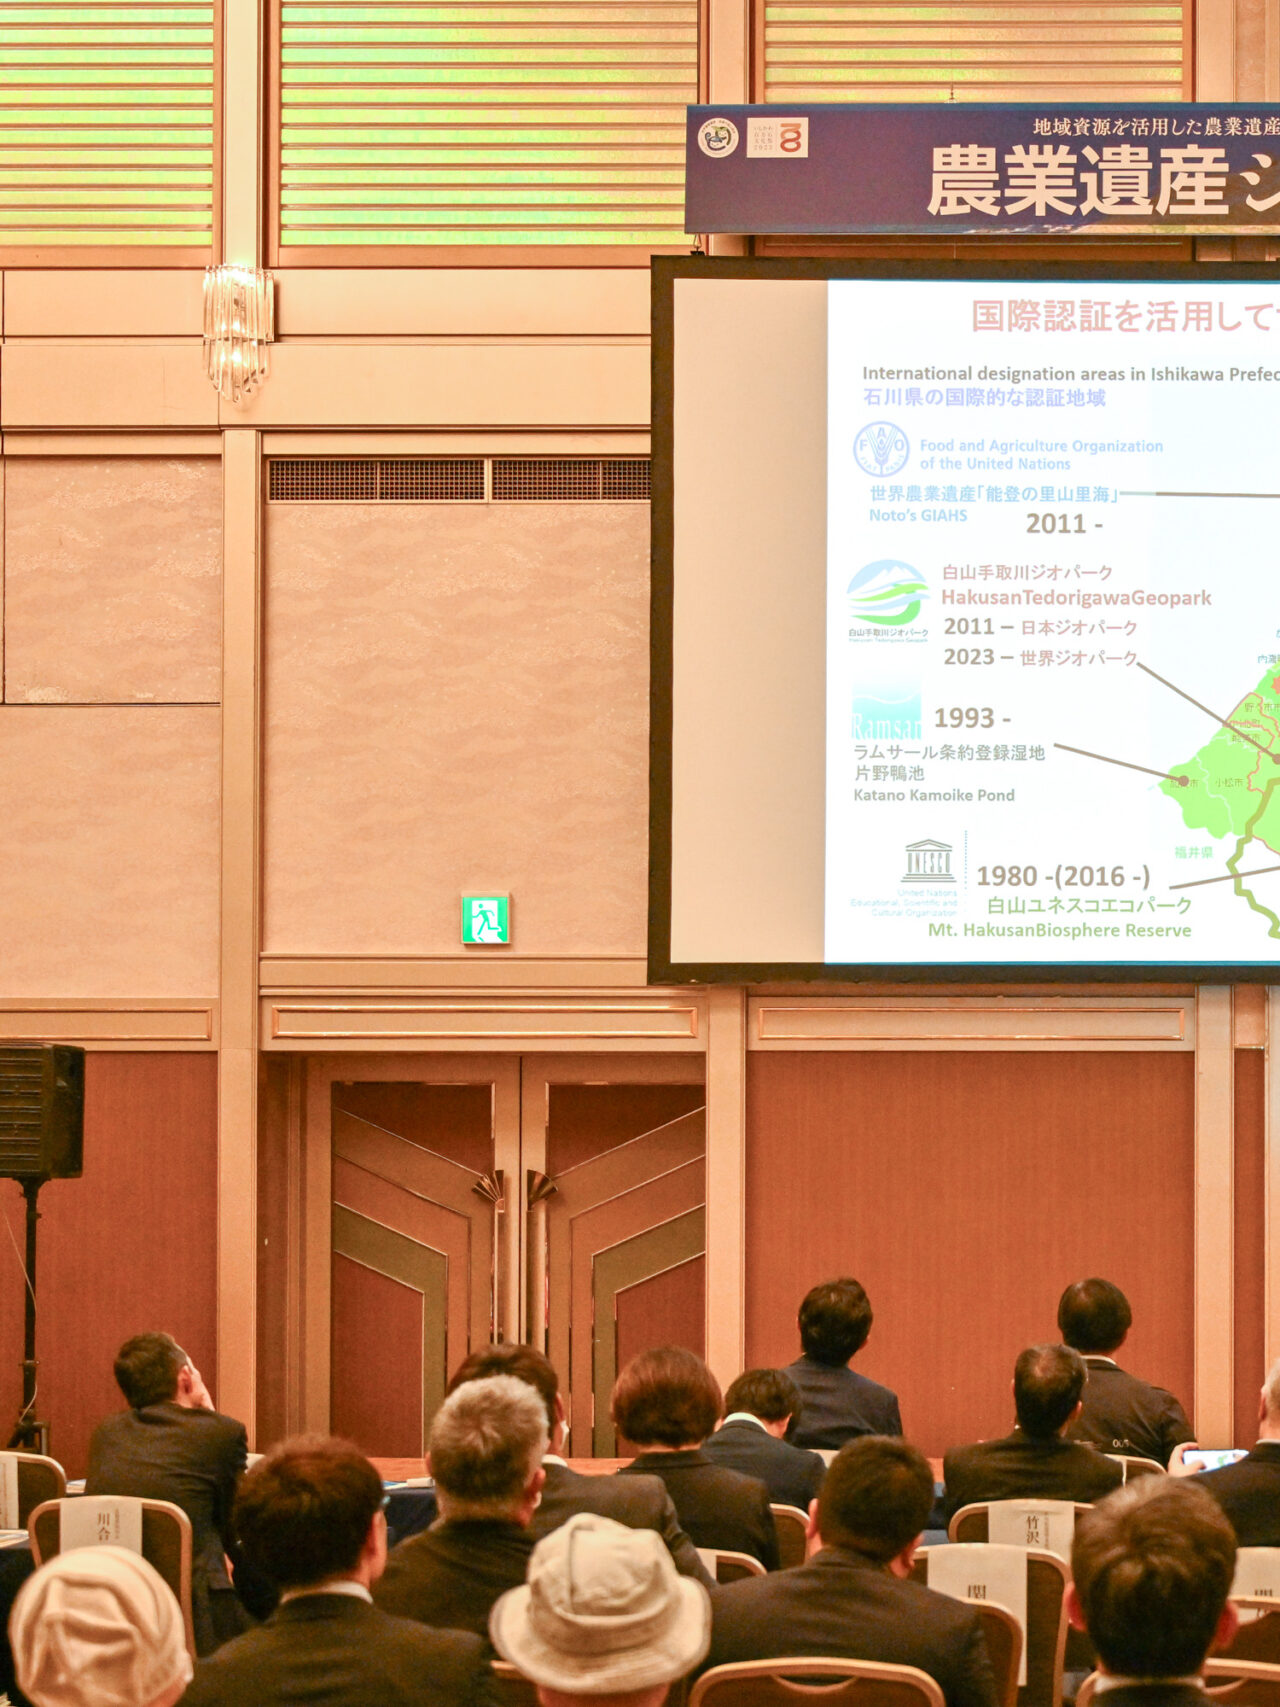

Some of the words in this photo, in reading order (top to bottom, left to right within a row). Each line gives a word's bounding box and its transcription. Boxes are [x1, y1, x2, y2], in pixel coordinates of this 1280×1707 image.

[864, 366, 972, 380] International
[978, 366, 1075, 384] designation
[1081, 371, 1125, 381] areas
[1131, 367, 1145, 381] in
[1152, 367, 1223, 381] Ishikawa
[864, 387, 1106, 407] 石川県の国際的な認証地域
[920, 438, 954, 451] Food
[959, 439, 984, 452] and
[989, 440, 1067, 456] Agriculture
[1072, 440, 1163, 455] Organization
[920, 456, 935, 470] of
[939, 456, 962, 470] the
[967, 457, 1013, 470] United
[1018, 458, 1072, 470] Nations
[870, 485, 1120, 503] 世界農業遺産「能登の里山里海」
[921, 509, 967, 522] GIAHS
[1027, 513, 1086, 534] 2011
[944, 564, 1112, 581] 白山手取川ジオパーク
[942, 589, 1211, 609] HakusanTedorigawaGeopark
[945, 618, 994, 634] 2011
[1022, 619, 1136, 636] 日本ジオパーク
[945, 648, 994, 665] 2023
[1020, 650, 1138, 667] 世界ジオパーク
[936, 707, 994, 728] 1993
[854, 744, 1045, 761] ラムサール条約登録湿地
[856, 765, 925, 781] 片野鴨池
[855, 789, 905, 801] Katano
[910, 789, 973, 801] Kamoike
[978, 789, 1015, 801] Pond
[1175, 846, 1213, 859] 福井県
[978, 866, 1037, 886] 1980
[1045, 864, 1125, 890] -(2016
[1133, 865, 1149, 890] -)
[989, 896, 1191, 914] 白山ユネスコエコパーク
[929, 923, 957, 936] Mt.
[964, 922, 1120, 940] HakusanBiosphere
[1126, 924, 1191, 937] Reserve
